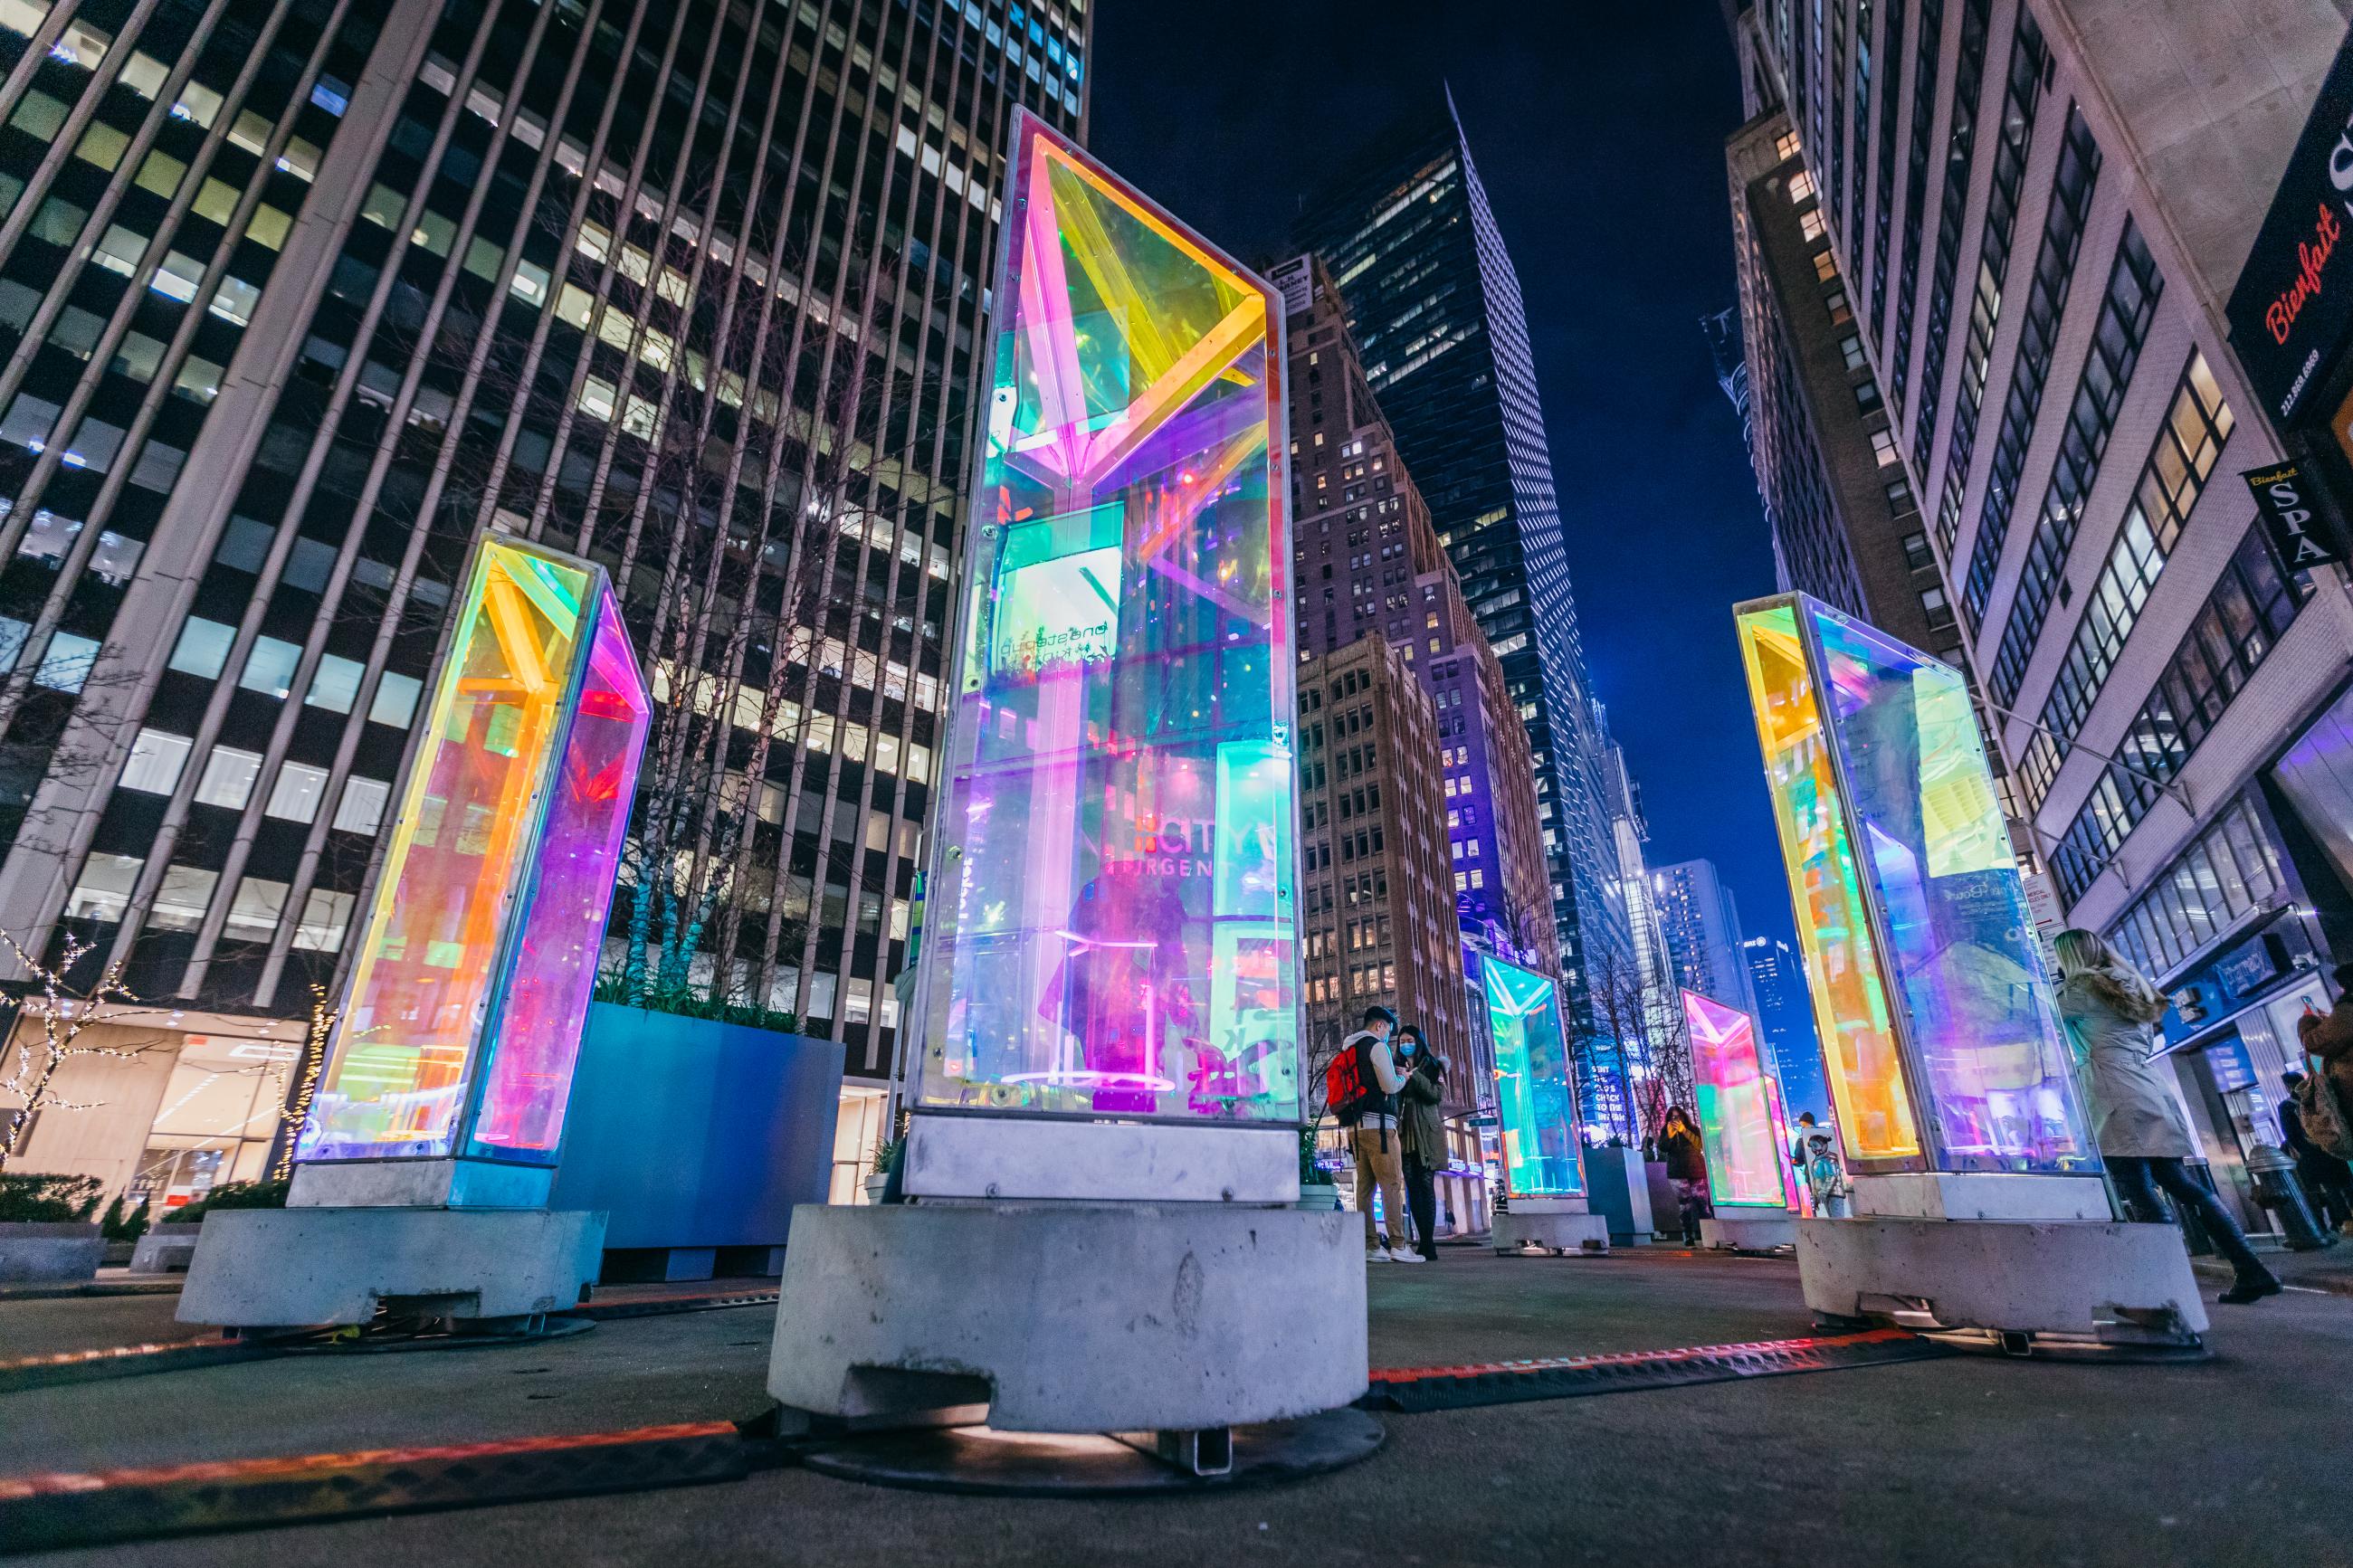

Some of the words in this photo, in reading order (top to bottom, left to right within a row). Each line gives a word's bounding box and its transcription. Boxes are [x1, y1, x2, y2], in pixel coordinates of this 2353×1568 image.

[2266, 203, 2339, 345] Bienfait
[2250, 467, 2298, 487] Bienfait
[2269, 481, 2331, 563] SPA
